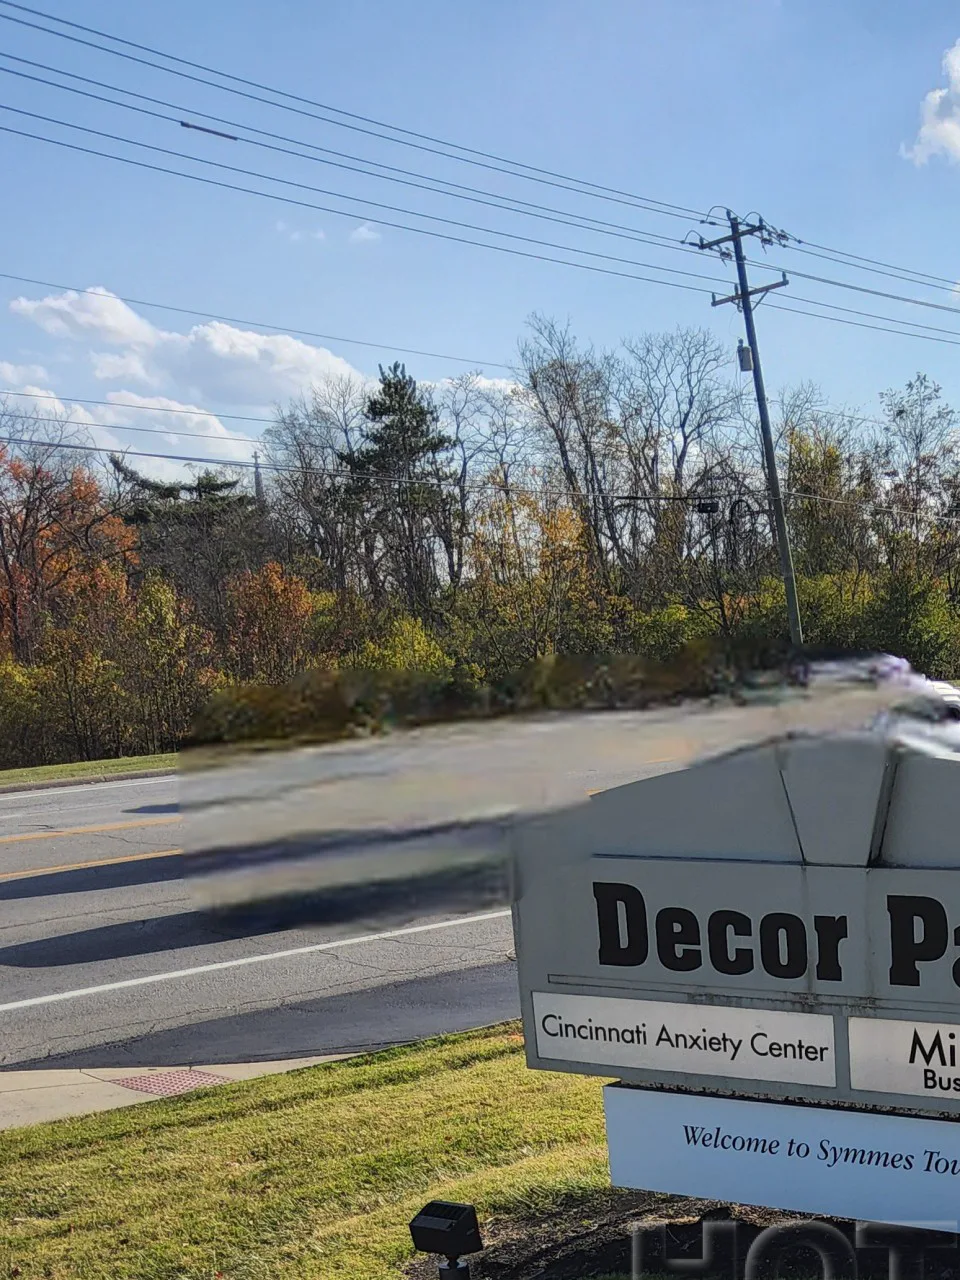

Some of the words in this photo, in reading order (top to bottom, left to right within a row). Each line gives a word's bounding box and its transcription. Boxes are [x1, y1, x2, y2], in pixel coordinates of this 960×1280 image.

[592, 881, 848, 982] Decor
[541, 1014, 648, 1046] Cincinnati
[655, 1024, 743, 1060] Anxiety
[750, 1032, 829, 1062] Center
[682, 1124, 780, 1155] Welcome
[787, 1138, 810, 1159] to
[816, 1139, 914, 1168] Symmes
